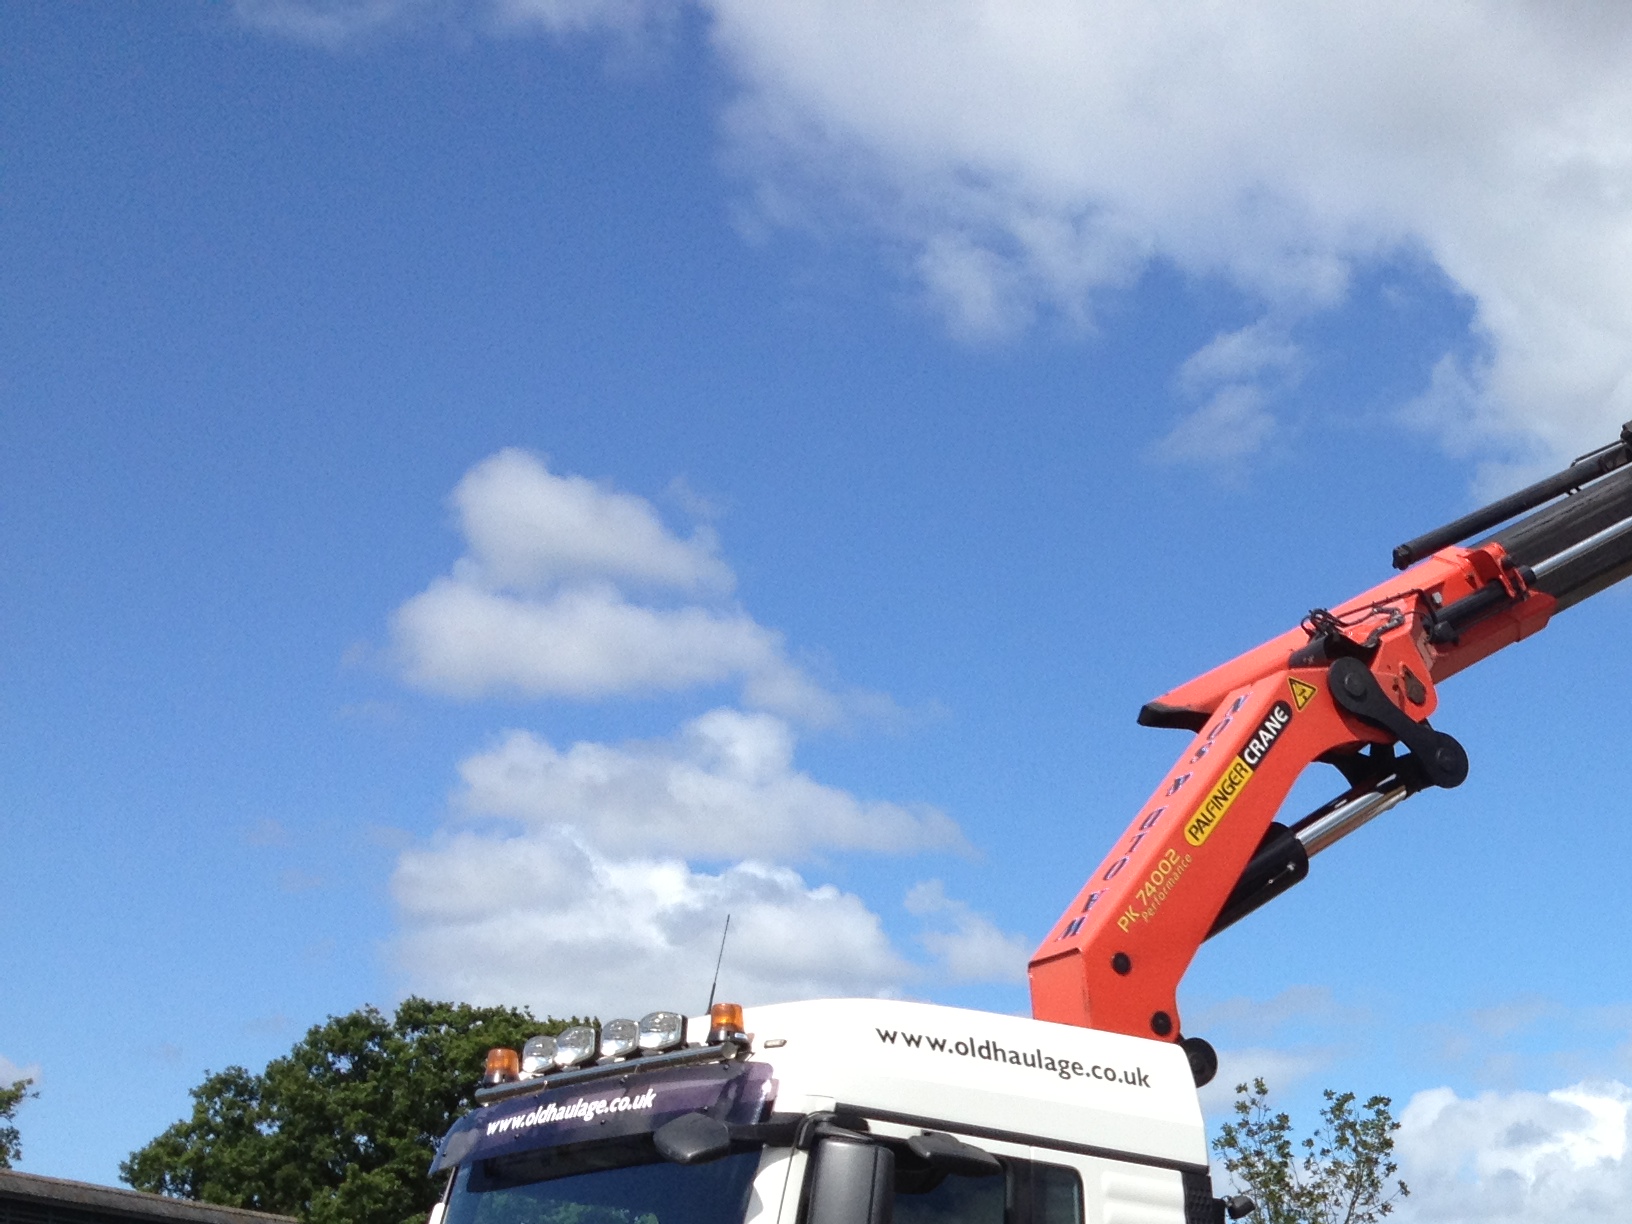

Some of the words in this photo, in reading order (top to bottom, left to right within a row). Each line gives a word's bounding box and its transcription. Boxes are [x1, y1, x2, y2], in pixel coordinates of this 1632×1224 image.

[1187, 761, 1249, 842] PALFINGER
[1243, 706, 1289, 765] CRANE
[1117, 904, 1140, 933] PK
[1135, 848, 1181, 905] 74002
[1141, 853, 1193, 923] Performance
[875, 1027, 1151, 1089] www.oldhaulage.co.uk
[486, 1088, 658, 1137] www.oldhaulage.co.uk
